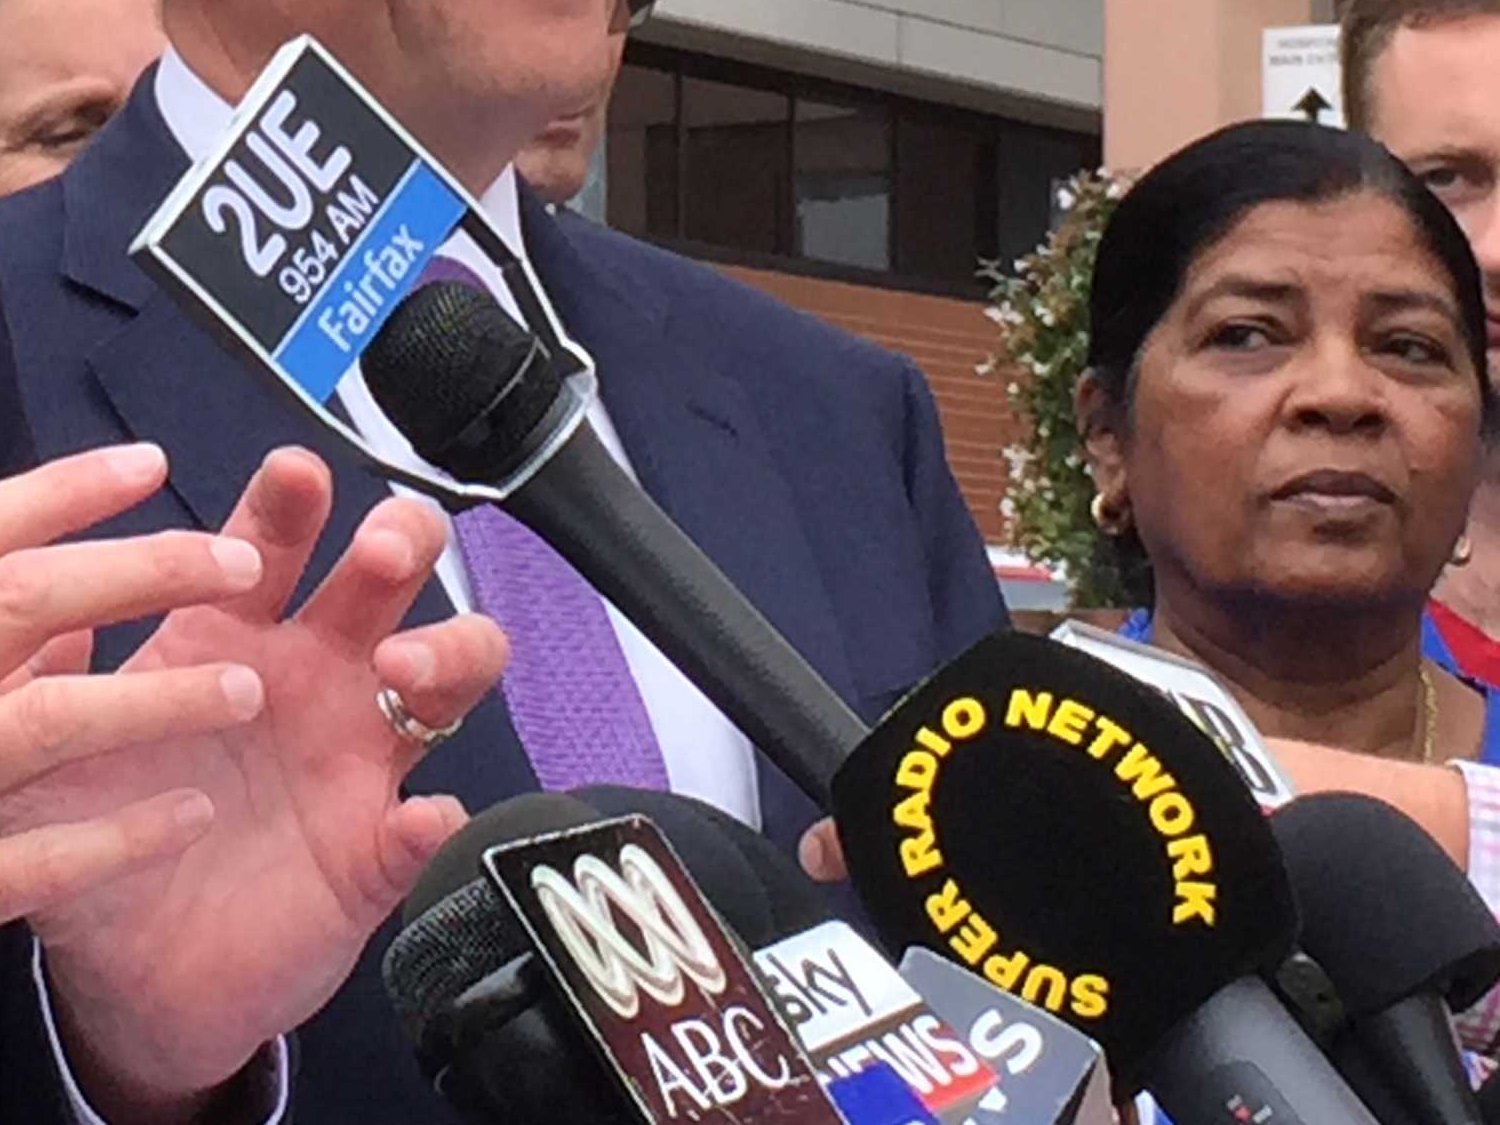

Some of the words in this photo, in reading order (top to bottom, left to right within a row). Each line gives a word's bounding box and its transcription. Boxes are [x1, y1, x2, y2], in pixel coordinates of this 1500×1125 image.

[202, 89, 352, 277] 2UE
[279, 229, 339, 304] 954
[326, 174, 380, 245] AM
[317, 224, 425, 353] Fairfax
[893, 697, 986, 878] RADIO
[1005, 689, 1217, 926] NETWORK
[925, 878, 1109, 1017] SUPER
[640, 1006, 791, 1119] ABC
